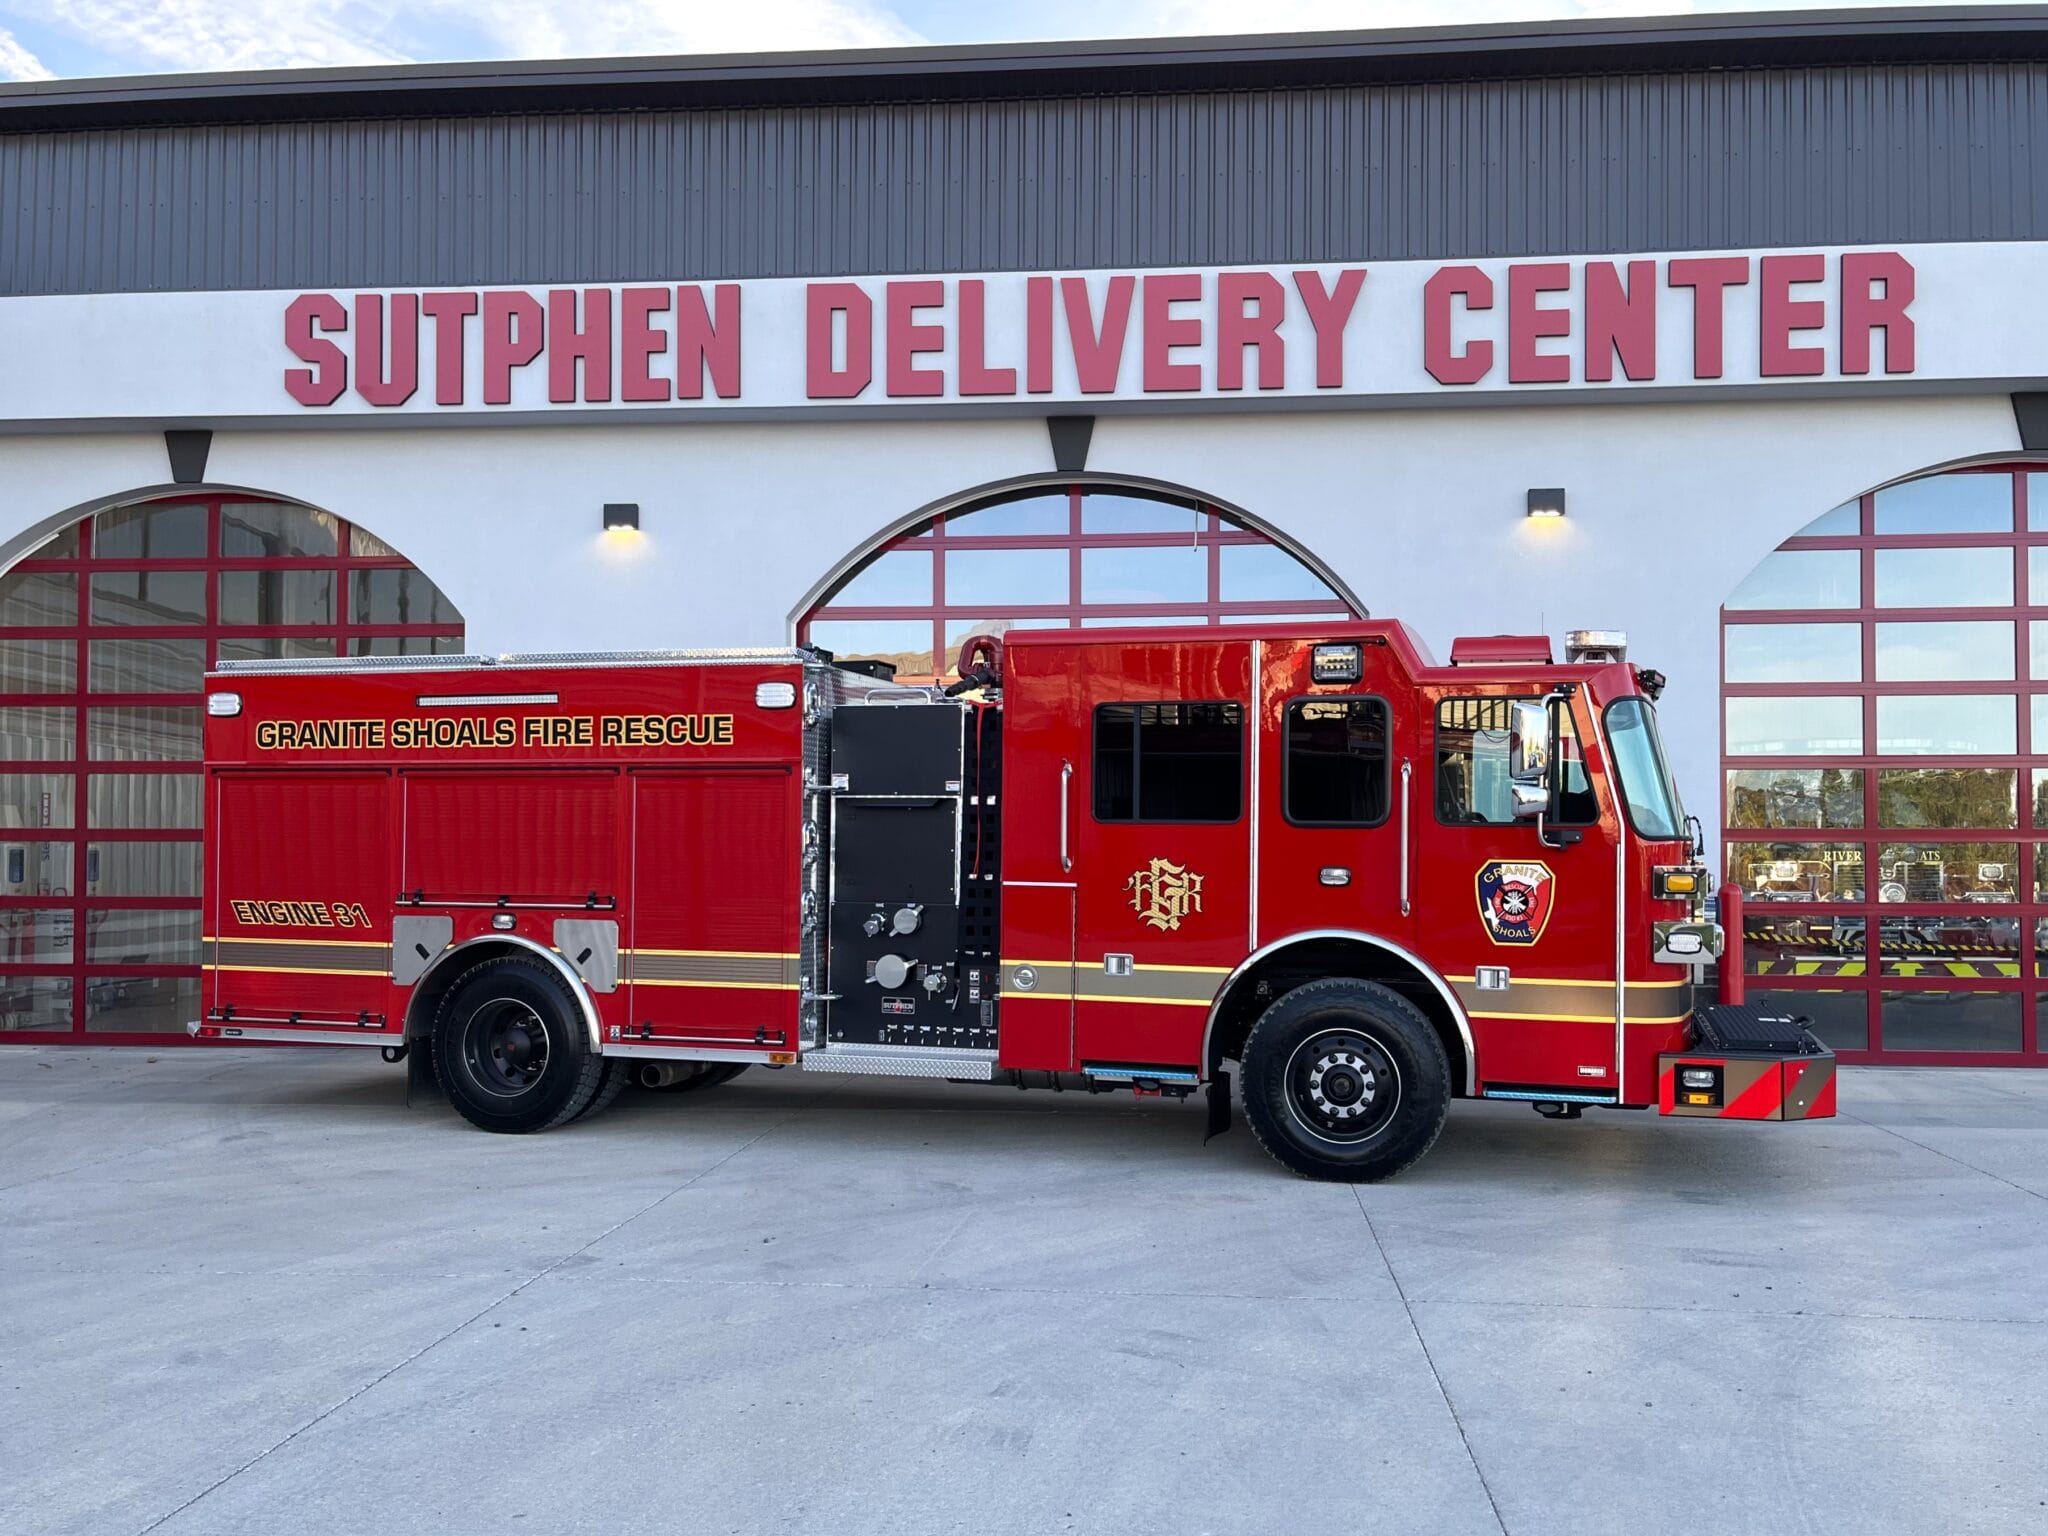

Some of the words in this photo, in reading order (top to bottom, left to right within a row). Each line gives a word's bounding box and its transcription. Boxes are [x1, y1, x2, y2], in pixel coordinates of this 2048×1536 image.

[285, 284, 741, 406] SUTPHEN
[806, 269, 1368, 399] DELIVERY
[1424, 252, 1915, 385] CENTER
[256, 719, 386, 750] GRANITE
[391, 717, 516, 748] SHOALS
[523, 716, 593, 747] FIRE
[601, 714, 734, 745] RESCUE
[1822, 850, 1862, 861] RIVER
[1483, 865, 1551, 883] GRANITE
[230, 900, 335, 927] ENGINE
[332, 903, 373, 928] 31
[1493, 925, 1536, 938] SHOALS
